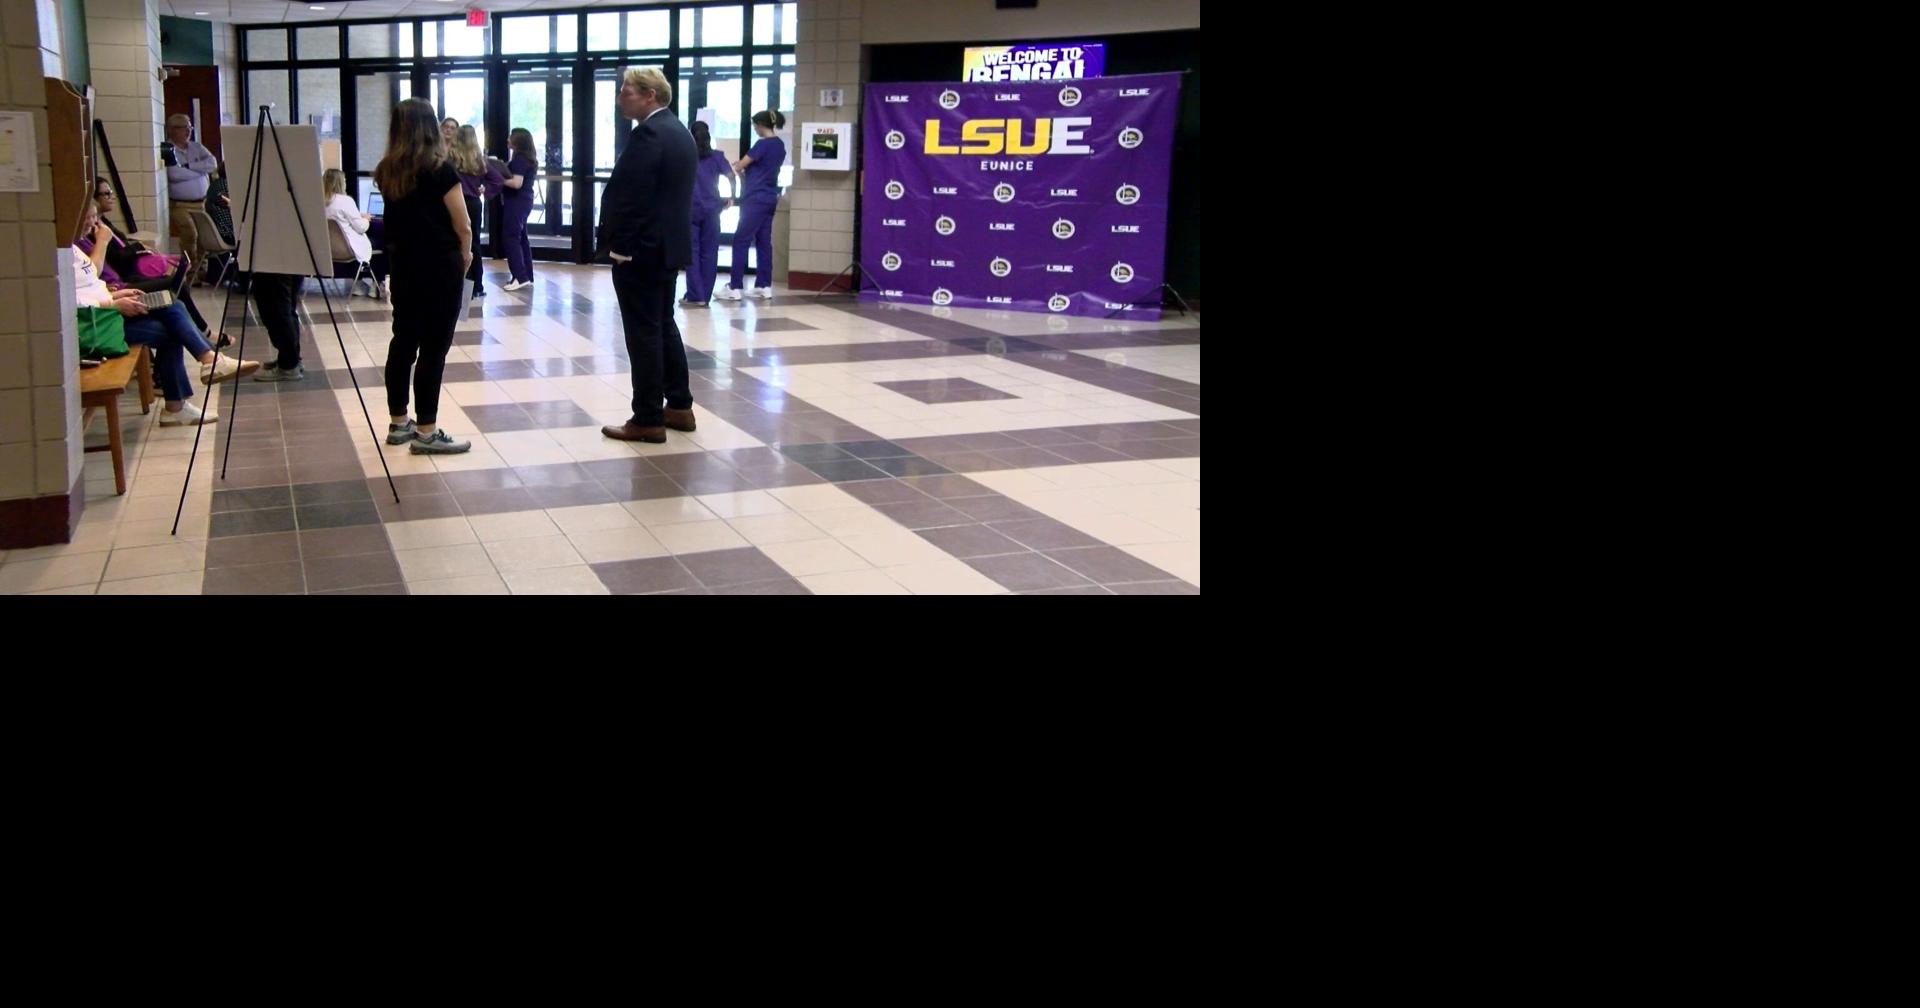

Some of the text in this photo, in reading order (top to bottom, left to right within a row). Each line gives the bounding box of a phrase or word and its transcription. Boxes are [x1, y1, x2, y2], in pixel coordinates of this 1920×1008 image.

[983, 47, 1084, 66] WELCOME TO
[1118, 88, 1150, 97] LSUE
[884, 95, 909, 103] LSUE
[994, 93, 1021, 102] LSUE
[924, 117, 1092, 155] LSUE
[980, 160, 1034, 171] EUNICE
[933, 186, 958, 195] LSUE
[1050, 188, 1078, 197] LSUE
[882, 218, 906, 227] LSUE
[989, 222, 1015, 231] LSUE
[1111, 224, 1140, 233] LSUE
[930, 259, 955, 268] LSUE
[1046, 264, 1074, 273] LSUE
[986, 295, 1012, 304] LSUE
